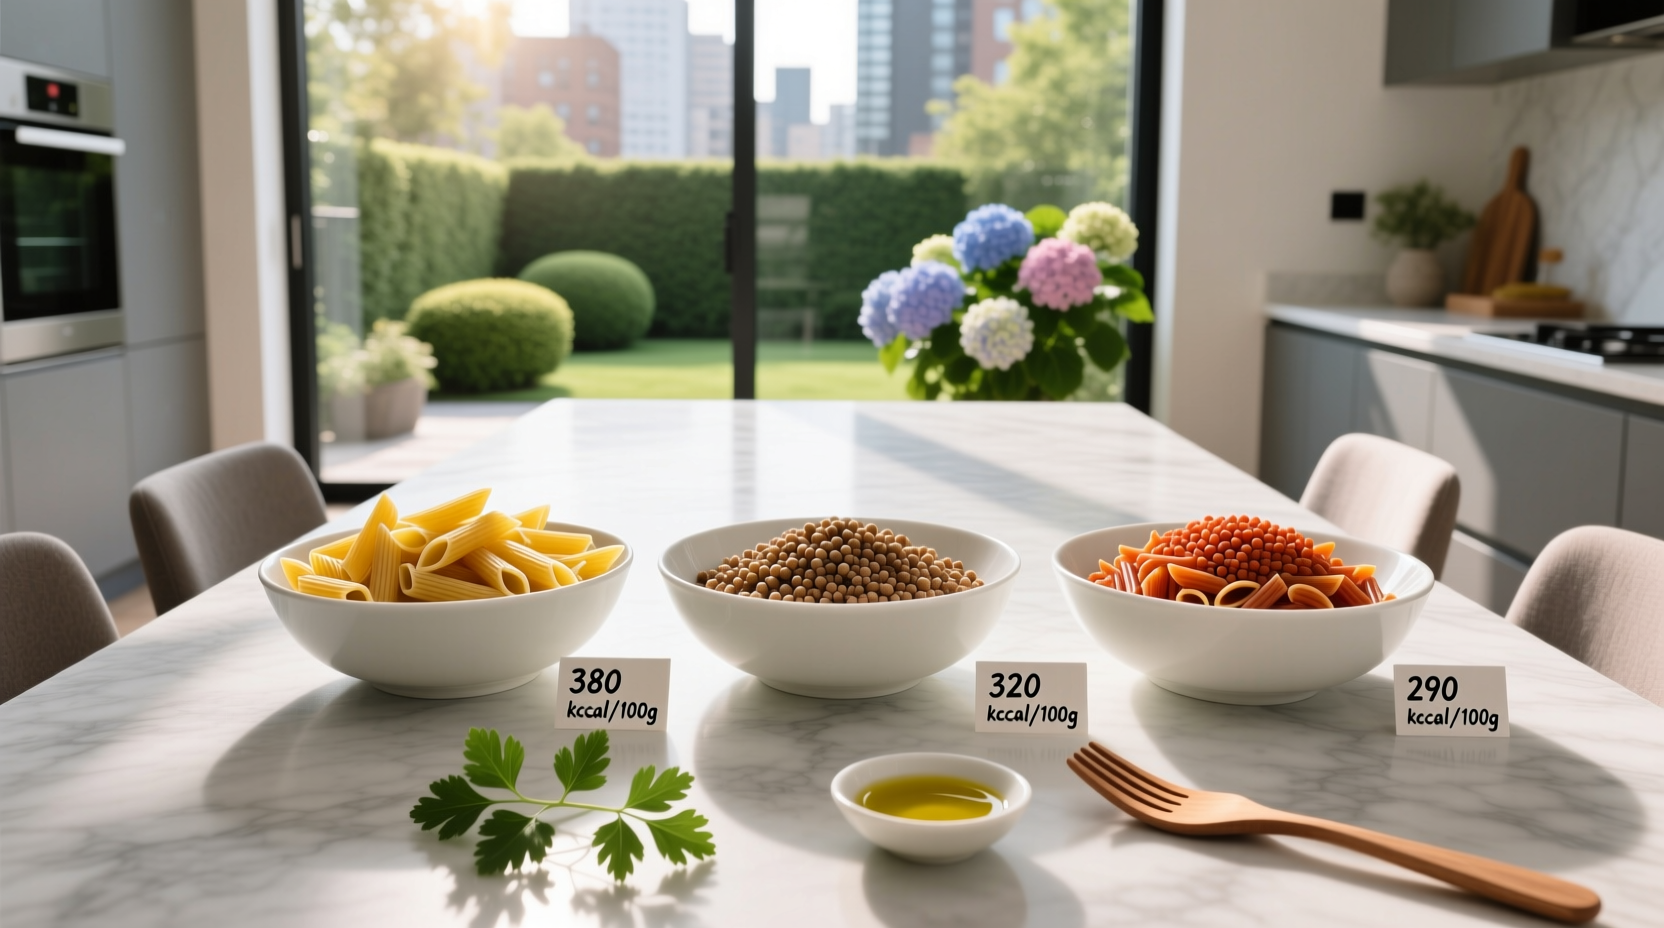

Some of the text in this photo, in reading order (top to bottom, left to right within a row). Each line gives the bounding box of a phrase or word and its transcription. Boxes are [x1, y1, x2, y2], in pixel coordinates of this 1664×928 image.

[568, 667, 622, 695] 380
[988, 672, 1041, 699] 320
[1406, 675, 1459, 702] 290
[566, 699, 658, 726] kccal/100g
[986, 703, 1079, 730] kccal/100g
[1407, 706, 1499, 732] kccal/100g
